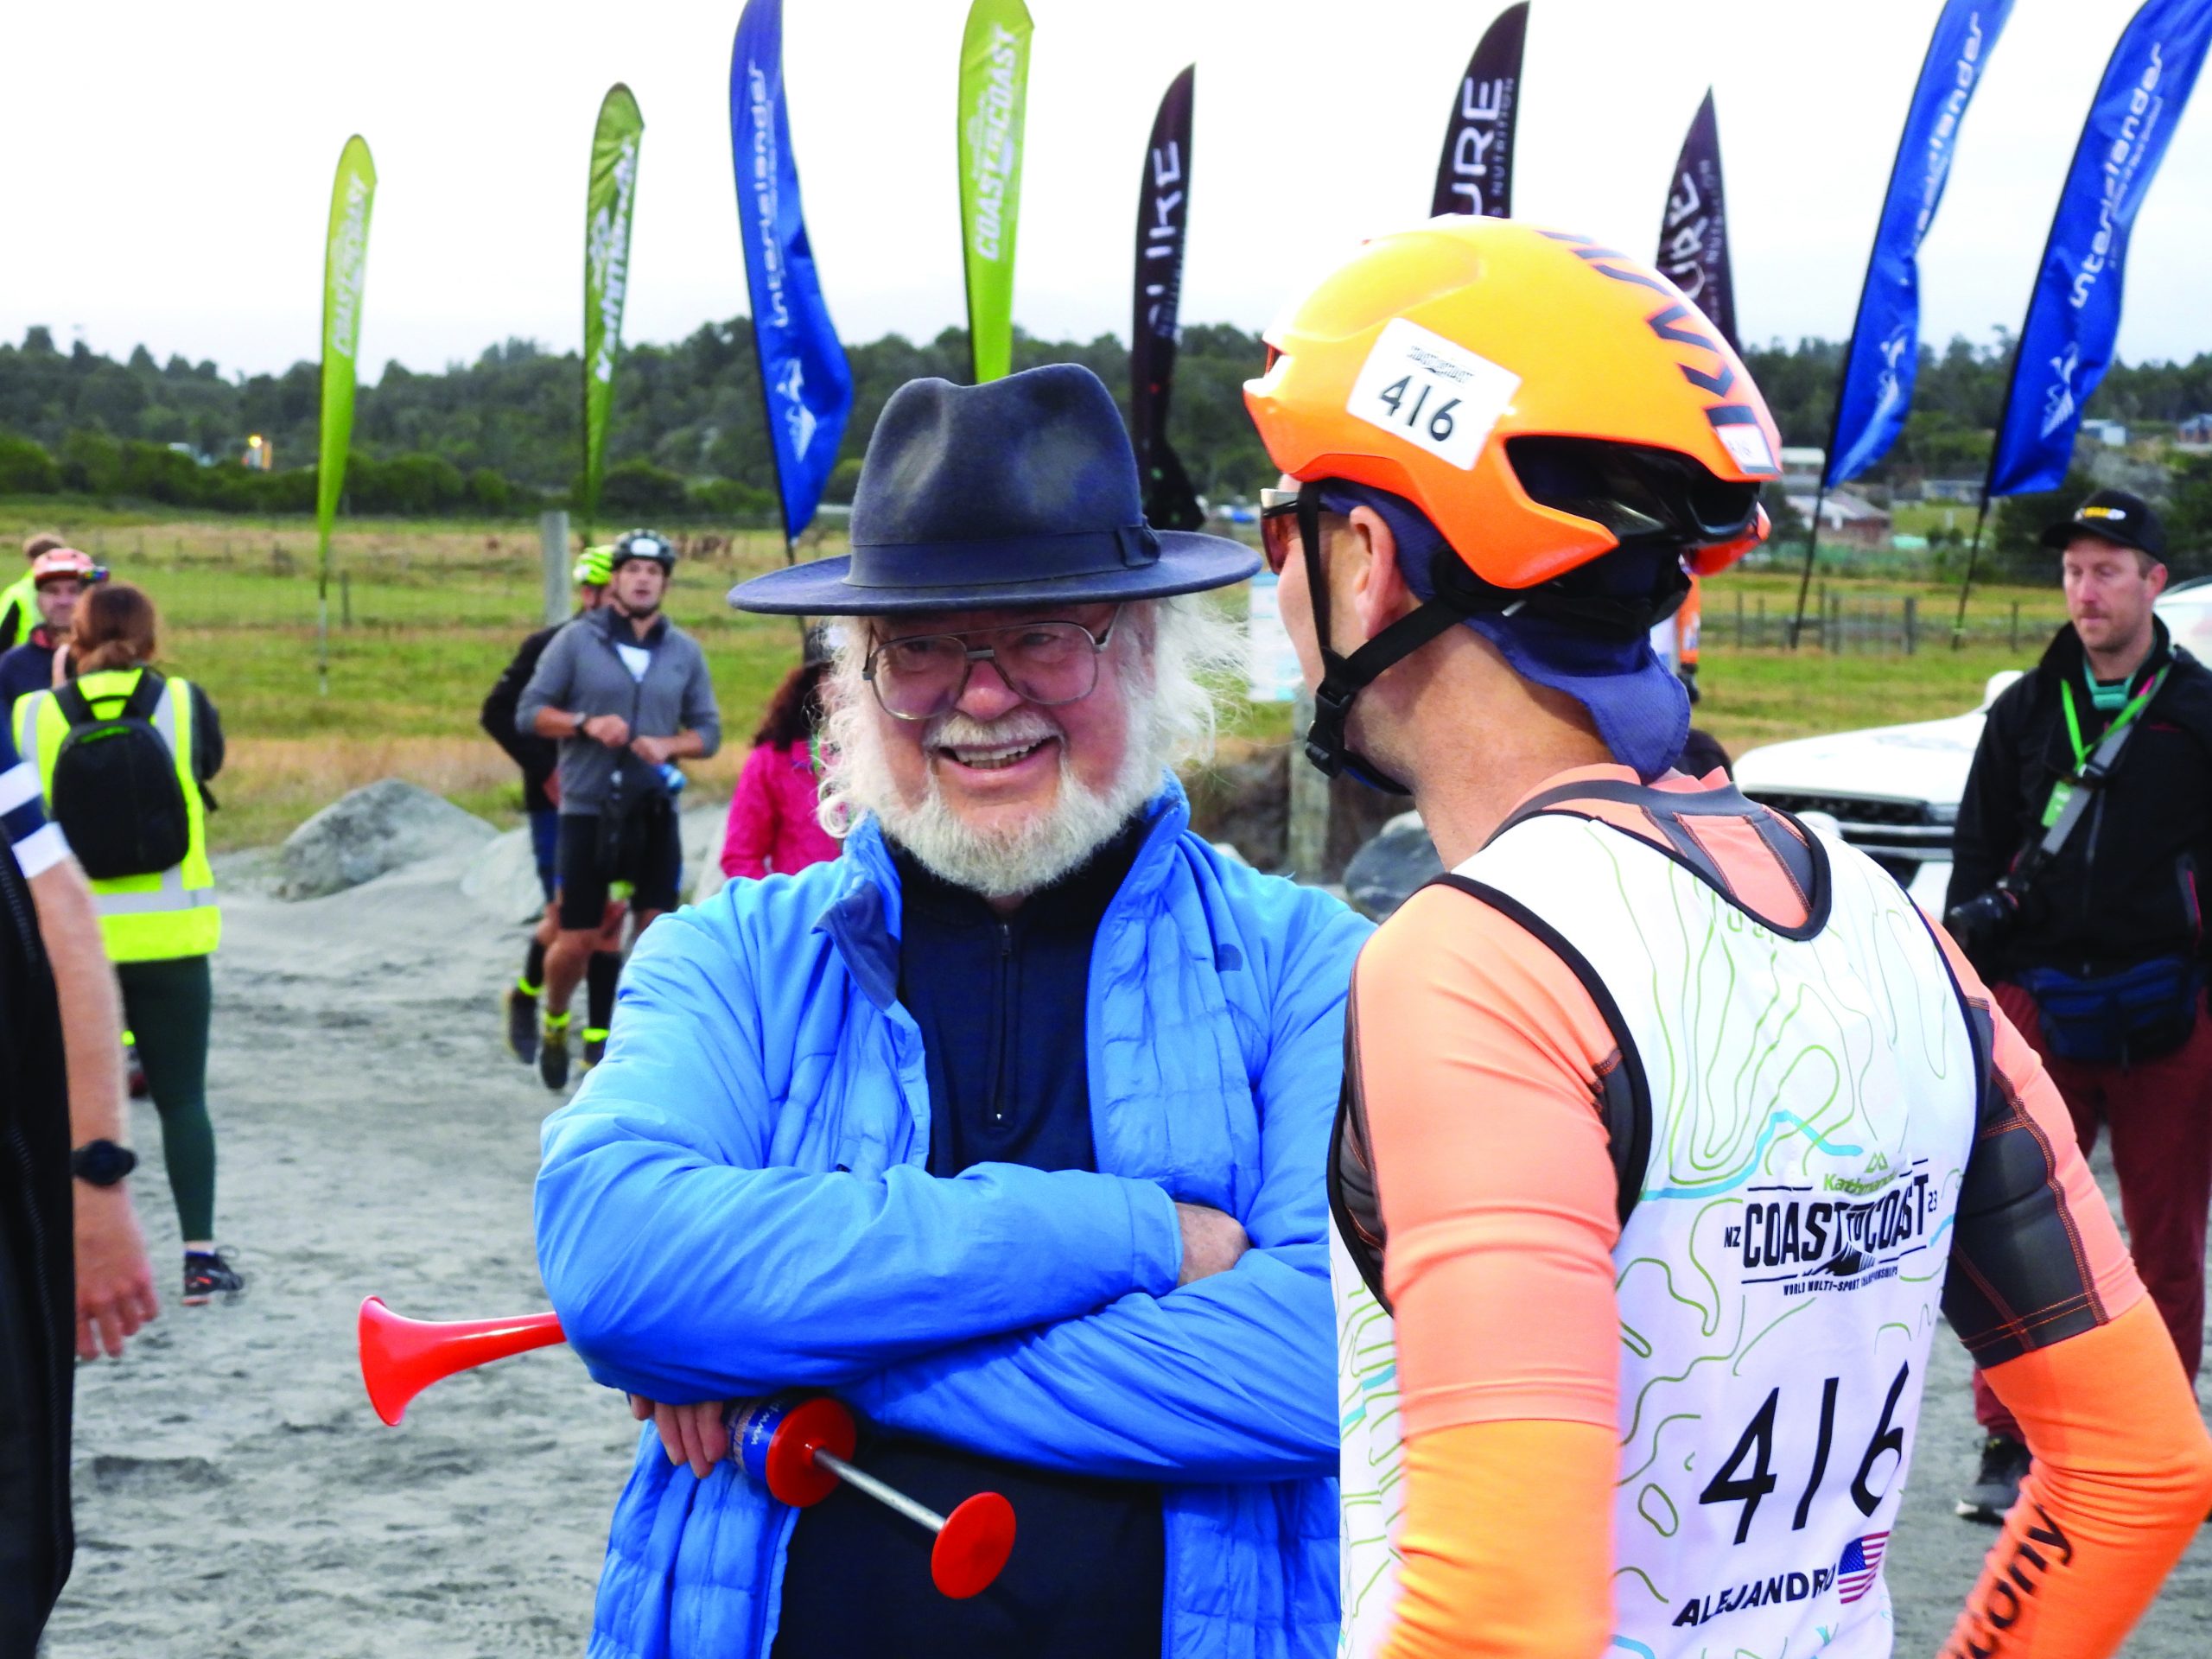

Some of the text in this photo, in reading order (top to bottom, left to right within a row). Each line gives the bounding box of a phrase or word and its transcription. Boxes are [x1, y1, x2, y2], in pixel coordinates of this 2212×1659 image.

[988, 22, 1017, 129] COAST
[976, 153, 1006, 262] COAST
[1378, 374, 1462, 442] 416
[1724, 1173, 1937, 1268] NZ COAST TO COAST 23
[1783, 1282, 1806, 1296] WORLD
[1808, 1277, 1860, 1292] MULTI-SPORT
[1698, 1359, 1910, 1546] 416
[1671, 1562, 1837, 1627] ALEJANDRO
